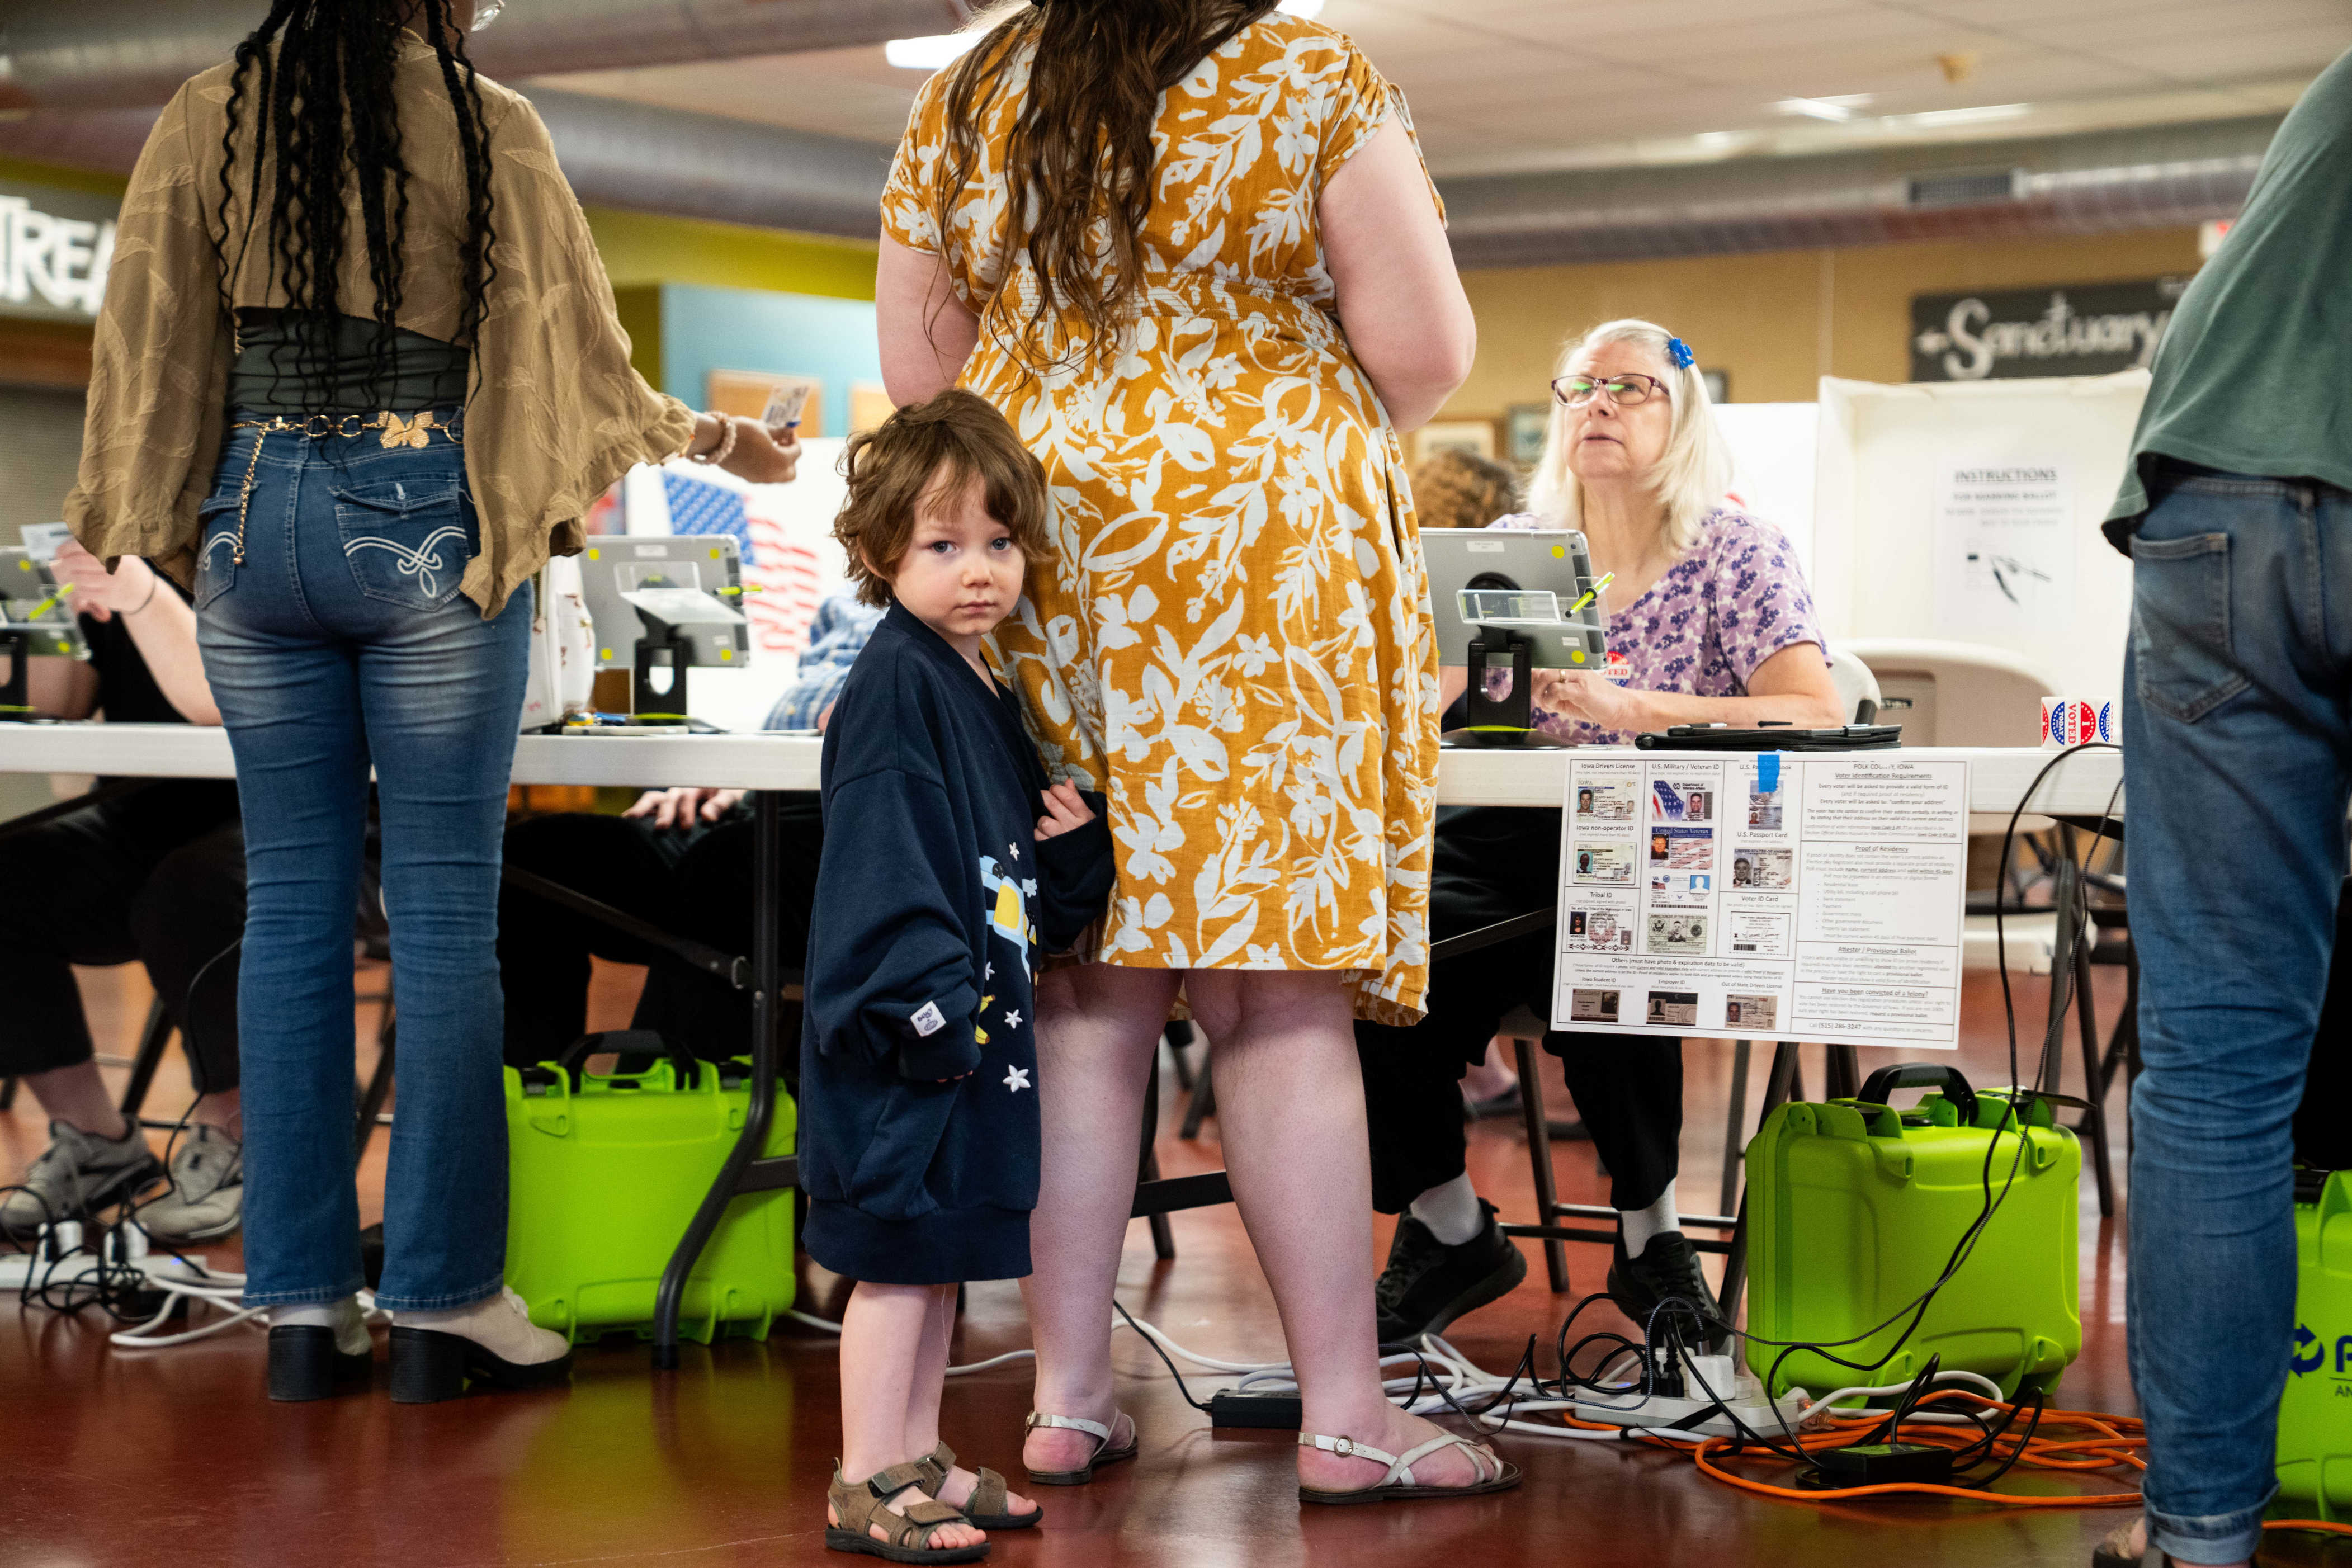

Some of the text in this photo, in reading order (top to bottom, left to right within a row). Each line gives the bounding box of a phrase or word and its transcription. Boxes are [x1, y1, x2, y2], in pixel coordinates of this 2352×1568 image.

[1943, 288, 2170, 379] Sanctuary
[1955, 467, 2057, 480] INSTRUCTIONS
[2068, 703, 2076, 744] VOTED
